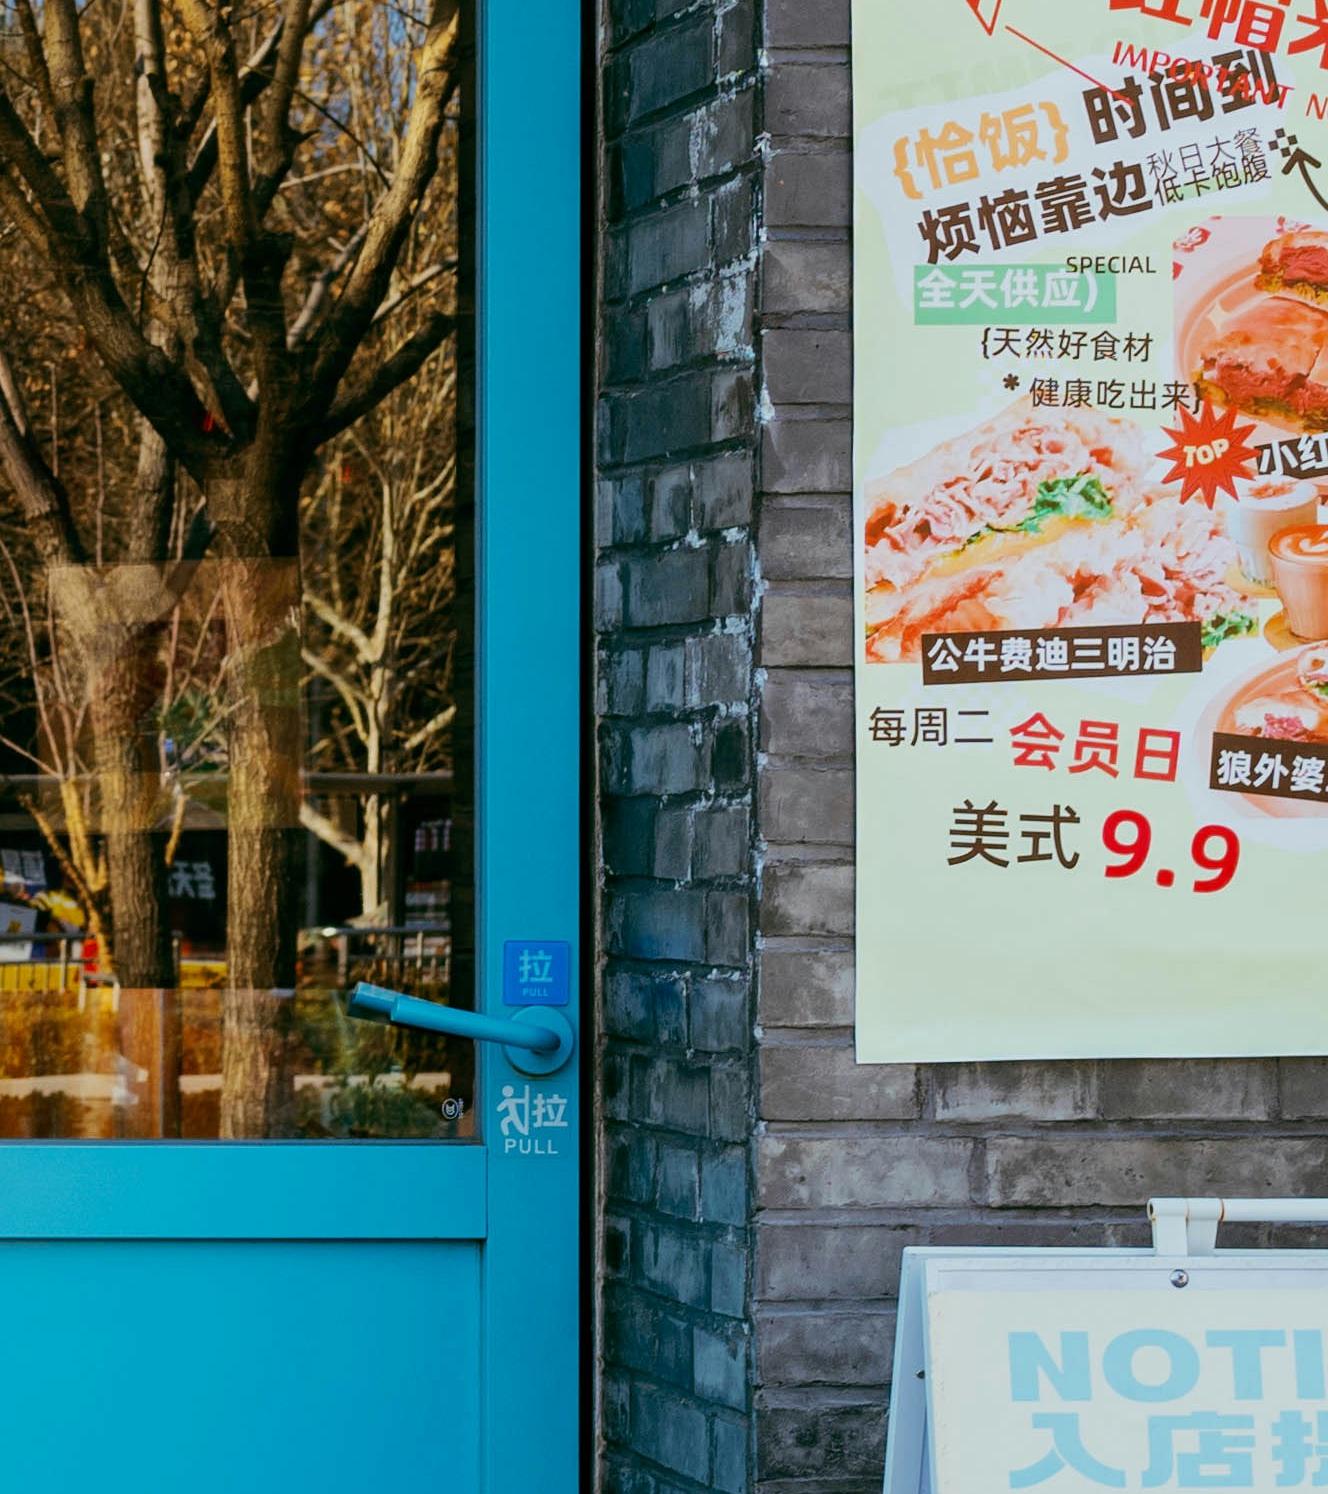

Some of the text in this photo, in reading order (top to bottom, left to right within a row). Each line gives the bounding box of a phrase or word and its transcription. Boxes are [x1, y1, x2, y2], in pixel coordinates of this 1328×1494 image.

[1082, 48, 1280, 145] 时间到
[1111, 40, 1295, 109] IMPORTANT
[1146, 127, 1264, 180] 秋日大餐
[1154, 154, 1272, 207] 低卡饱腹
[916, 160, 1154, 265] 烦恼靠边
[1065, 255, 1157, 274] SPECIAL
[1182, 438, 1231, 468] TOP
[926, 634, 1178, 675] 公牛费迪三明治
[867, 706, 1182, 783] 每周二 会员日
[946, 798, 1241, 893] 美式 9.9
[518, 949, 553, 983] 拉
[521, 987, 549, 997] PULL
[531, 1093, 569, 1128] 拉
[504, 1138, 559, 1154] PULL
[1007, 1328, 1327, 1403] NOTI
